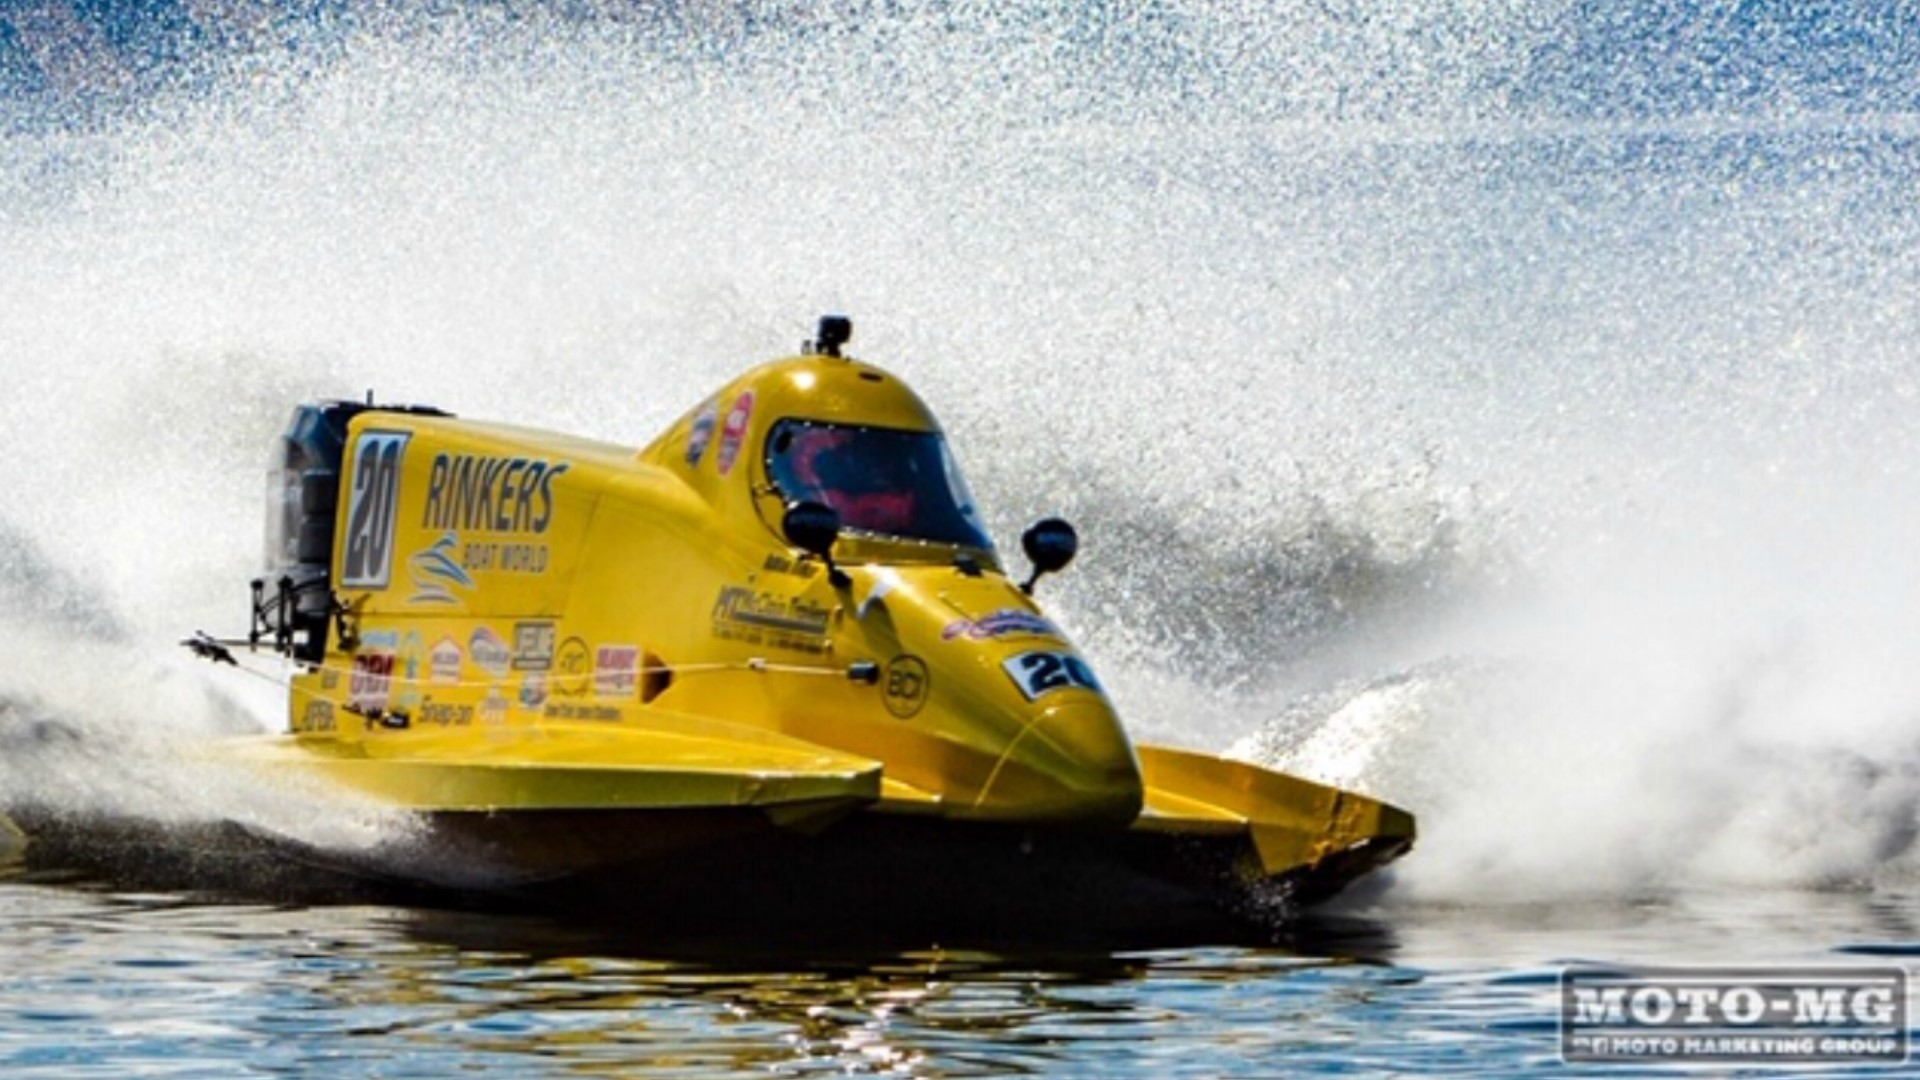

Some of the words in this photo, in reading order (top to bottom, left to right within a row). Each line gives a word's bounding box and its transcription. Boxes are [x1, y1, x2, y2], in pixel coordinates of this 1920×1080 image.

[344, 439, 400, 579] 20
[422, 453, 569, 534] RINKERS
[464, 543, 497, 571] BOAT
[501, 544, 549, 573] WORLD
